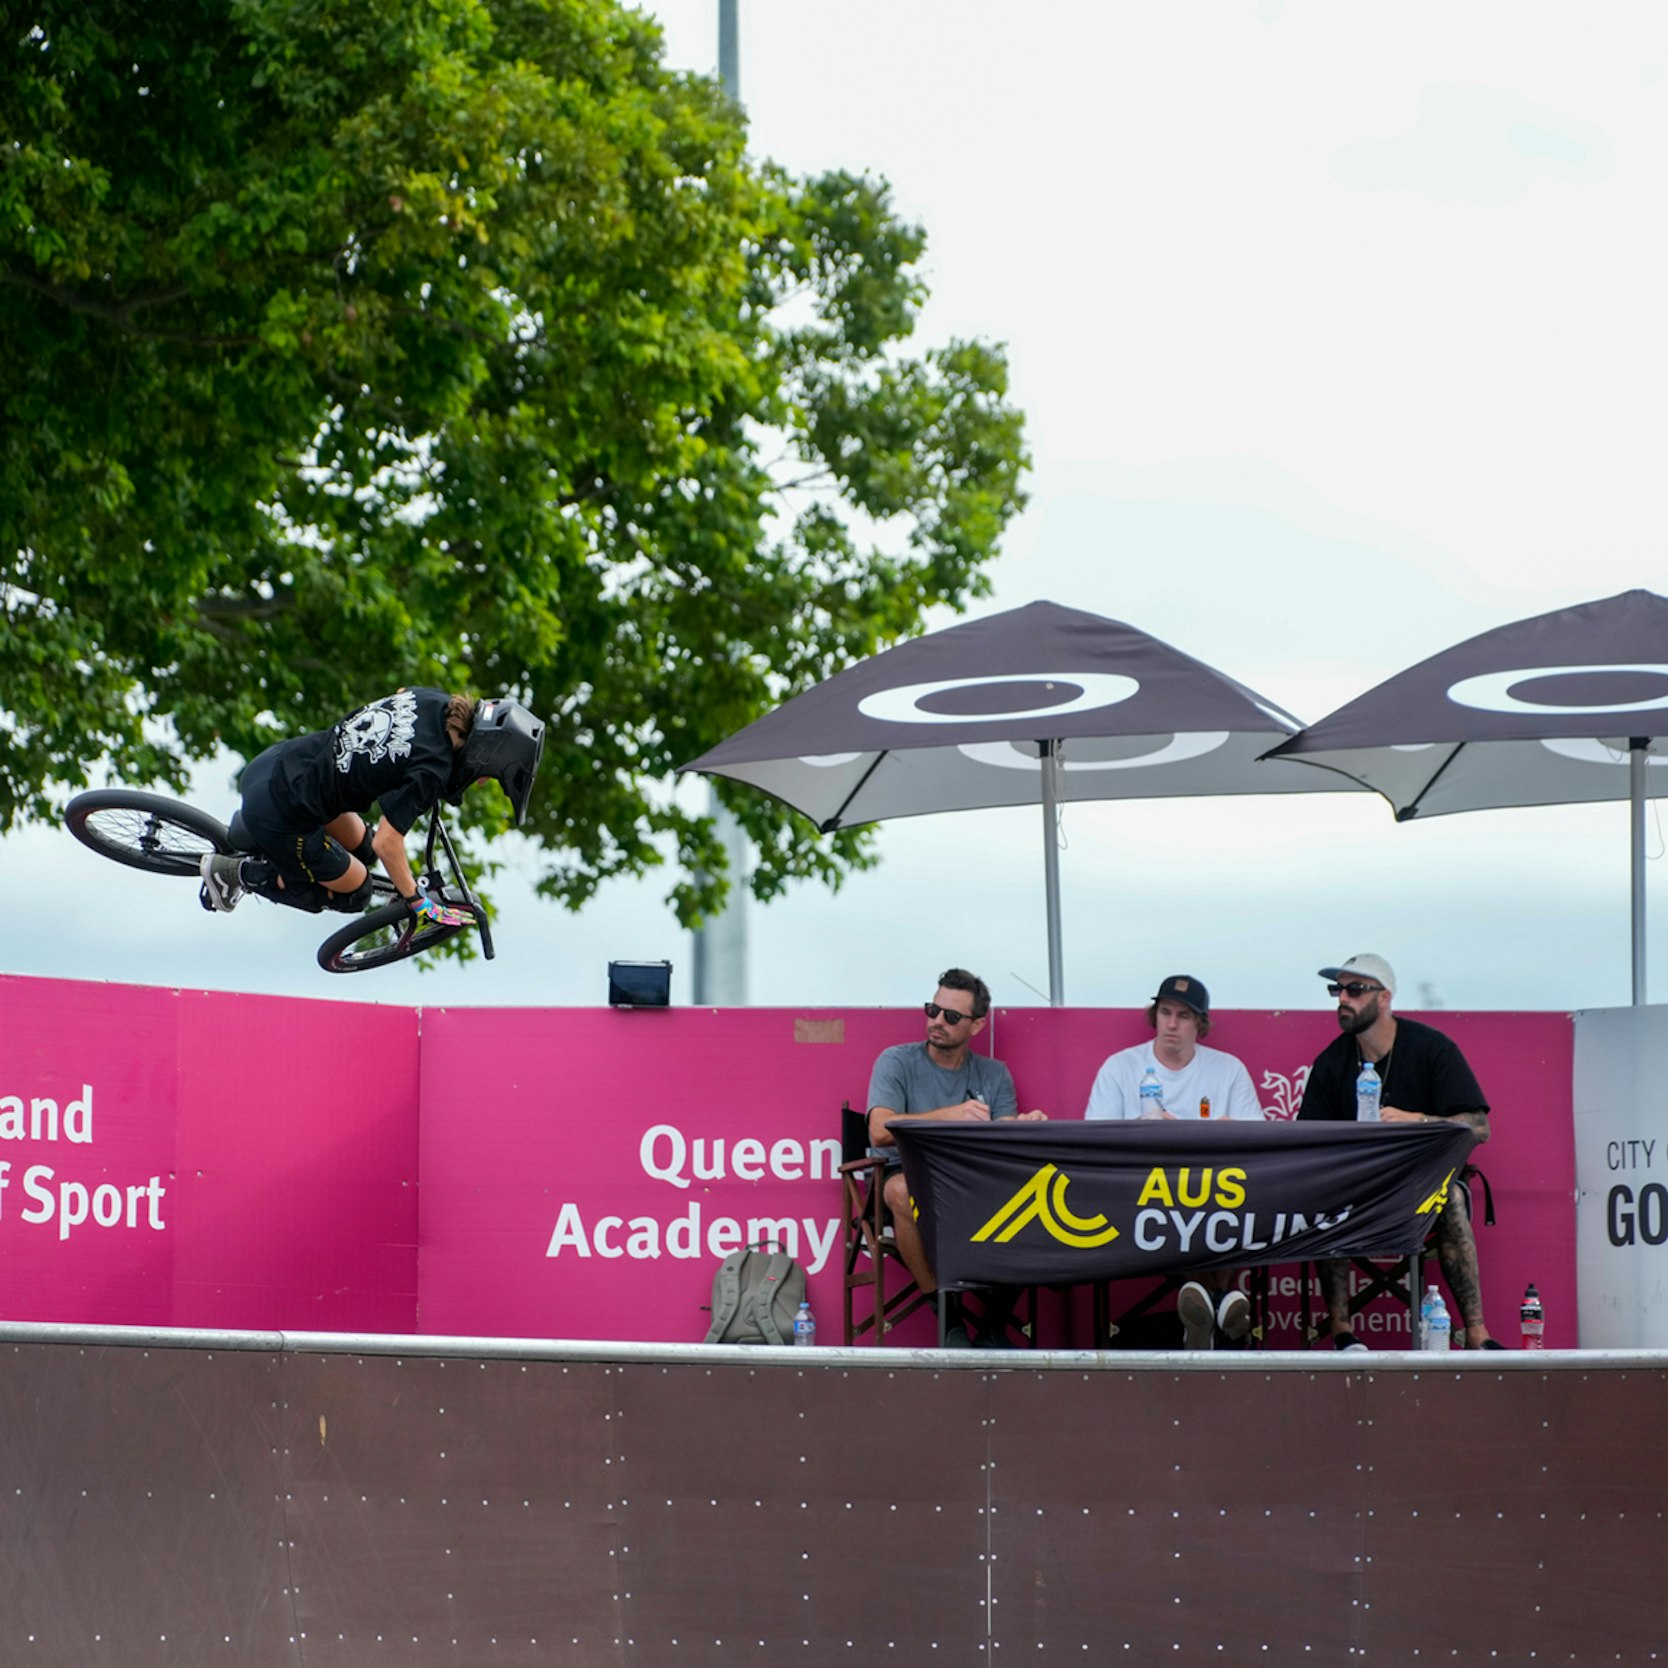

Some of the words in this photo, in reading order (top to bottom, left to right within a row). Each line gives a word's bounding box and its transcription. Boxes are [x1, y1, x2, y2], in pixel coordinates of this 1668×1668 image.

[639, 1124, 866, 1188] Queen
[1607, 1139, 1656, 1171] CITY
[20, 1164, 166, 1241] Sport
[1136, 1167, 1248, 1209] AUS
[546, 1201, 841, 1276] Academy
